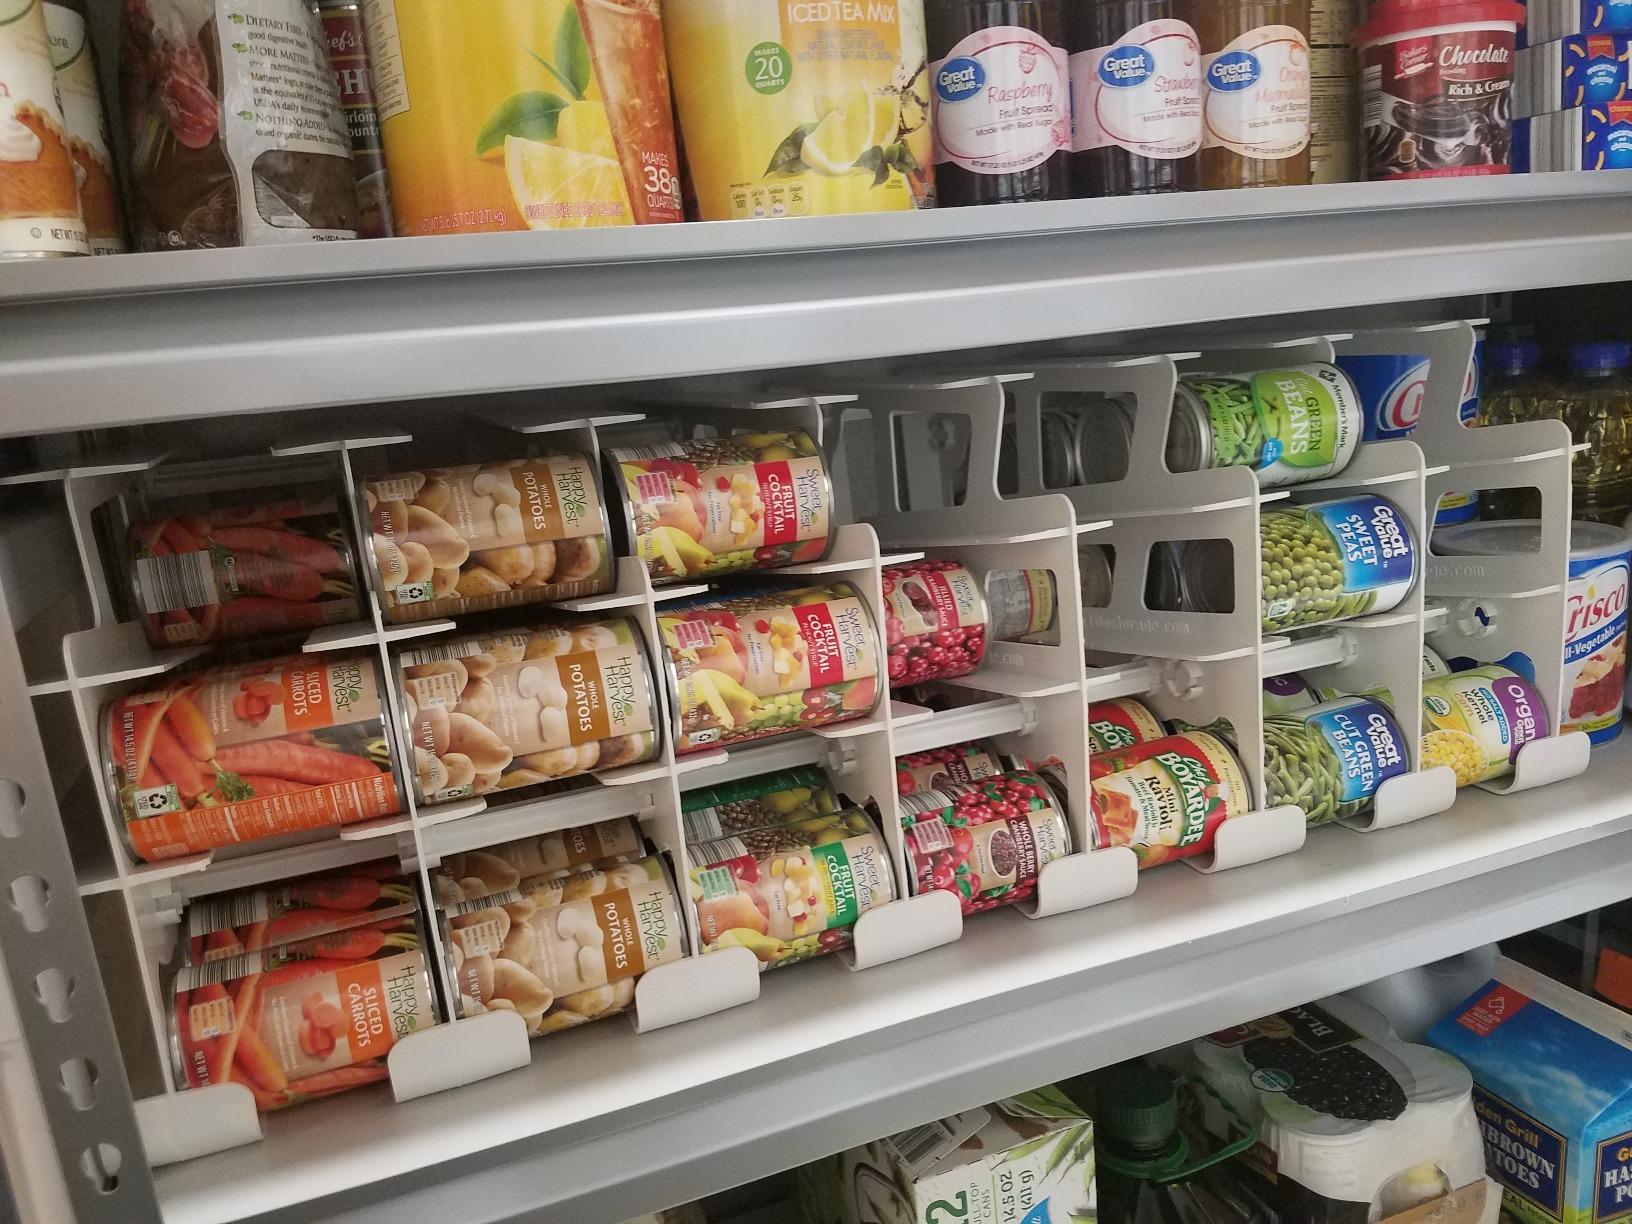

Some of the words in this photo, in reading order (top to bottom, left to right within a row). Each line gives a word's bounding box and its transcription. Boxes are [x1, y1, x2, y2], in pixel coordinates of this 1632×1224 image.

[246, 15, 284, 31] DIETARY
[787, 4, 830, 23] ICED
[834, 2, 862, 22] TEA
[866, 4, 896, 23] MIX
[248, 31, 265, 41] good
[249, 45, 277, 57] MORE
[754, 47, 780, 56] MAKES
[754, 56, 784, 80] 20
[1102, 54, 1145, 72] Great
[1211, 62, 1252, 79] Great
[1439, 43, 1509, 67] Chocolate
[755, 78, 785, 89] QUARTS
[939, 66, 975, 85] Great
[946, 78, 976, 94] Value
[1114, 66, 1146, 79] Value
[1221, 72, 1253, 85] Value
[261, 87, 273, 95] the
[988, 80, 1053, 105] Raspberry
[1165, 98, 1181, 107] Fruit
[1449, 84, 1473, 95] Rich
[1475, 83, 1484, 94] &
[256, 113, 303, 127] NOTHING
[282, 101, 299, 112] daily
[999, 105, 1020, 119] Fruit
[1021, 104, 1053, 119] Spread
[1143, 114, 1164, 123] Made
[1271, 104, 1288, 113] Fruit
[976, 126, 998, 137] Made
[1000, 124, 1016, 135] with
[1017, 121, 1033, 133] Real
[1248, 119, 1270, 129] Made
[642, 151, 669, 168] MAKES
[643, 165, 672, 194] 38
[1275, 380, 1307, 455] BEANS
[1333, 384, 1347, 422] Member's
[1305, 396, 1321, 451] GREEN
[1337, 424, 1347, 449] Mark
[522, 472, 547, 531] POTATOES
[541, 484, 553, 509] WHOLE
[556, 473, 579, 525] Harvest
[567, 466, 588, 507] Happy
[807, 468, 823, 512] Sweet
[380, 511, 391, 524] NET
[768, 473, 784, 535] COCKTAIL
[780, 485, 796, 520] FRUIT
[795, 476, 815, 530] Harvest
[1335, 523, 1363, 562] PEAS
[1346, 514, 1378, 566] SWEET
[1371, 517, 1393, 559] Value
[1373, 505, 1409, 558] Great
[926, 575, 943, 607] CRANBERRY
[939, 607, 949, 628] SAUCE
[938, 585, 952, 611] JELLIED
[821, 623, 838, 657] FRUIT
[835, 614, 857, 668] Harvest
[845, 607, 865, 648] Sweet
[1564, 624, 1616, 659] ll-Vegetable
[808, 614, 830, 674] COCKTAIL
[291, 670, 308, 716] CARROTS
[306, 672, 322, 704] SLICED
[588, 681, 599, 709] WHOLE
[605, 666, 627, 725] Harvest
[616, 656, 636, 704] Happy
[568, 664, 592, 732] POTATOES
[1457, 693, 1474, 717] Corn
[1463, 691, 1488, 724] Kernel
[1471, 688, 1494, 721] Whole
[1508, 684, 1536, 741] Organ
[123, 711, 133, 723] NET
[422, 721, 432, 734] NET
[1481, 690, 1491, 699] NO
[1490, 698, 1502, 715] SALT
[1498, 716, 1508, 742] ADDED
[424, 735, 435, 747] WT
[1332, 731, 1361, 778] BEANS
[1333, 714, 1363, 738] CUT
[1355, 741, 1375, 792] GREEN
[1366, 726, 1387, 769] Value
[1368, 713, 1402, 766] Great
[1183, 757, 1209, 783] Chef
[1127, 776, 1143, 798] Tomato
[1142, 804, 1150, 819] Meat
[1138, 781, 1149, 798] Beef
[1147, 798, 1157, 823] Ravioli
[1144, 775, 1173, 831] Ravioli
[1155, 752, 1206, 847] BOYARDEE
[1163, 786, 1178, 814] Mini
[1011, 820, 1023, 859] CRANBERRY
[1019, 859, 1027, 879] SAUCE
[1019, 821, 1032, 850] WHOLE
[1041, 818, 1056, 851] Sweet
[860, 845, 880, 887] Sweet
[1025, 851, 1035, 874] BERRY
[826, 854, 847, 915] COCKTAIL
[838, 864, 854, 899] FRUIT
[851, 854, 873, 909] Harvest
[637, 900, 658, 960] Harvest
[649, 891, 667, 939] Happy
[604, 902, 628, 969] POTATOES
[622, 917, 633, 946] WHOLE
[470, 968, 479, 982] NET
[386, 975, 410, 1037] Harvest
[401, 965, 420, 1018] Happy
[347, 983, 371, 1048] CARROTS
[364, 987, 384, 1036] SLICED
[194, 1051, 204, 1064] NET
[196, 1066, 208, 1081] WT
[1504, 1117, 1540, 1147] Grill
[1000, 1170, 1014, 1193] OZ
[1018, 1170, 1035, 1185] g)
[981, 1189, 992, 1218] CANS
[1003, 1194, 1017, 1222] 14.5
[1019, 1187, 1035, 1210] (411
